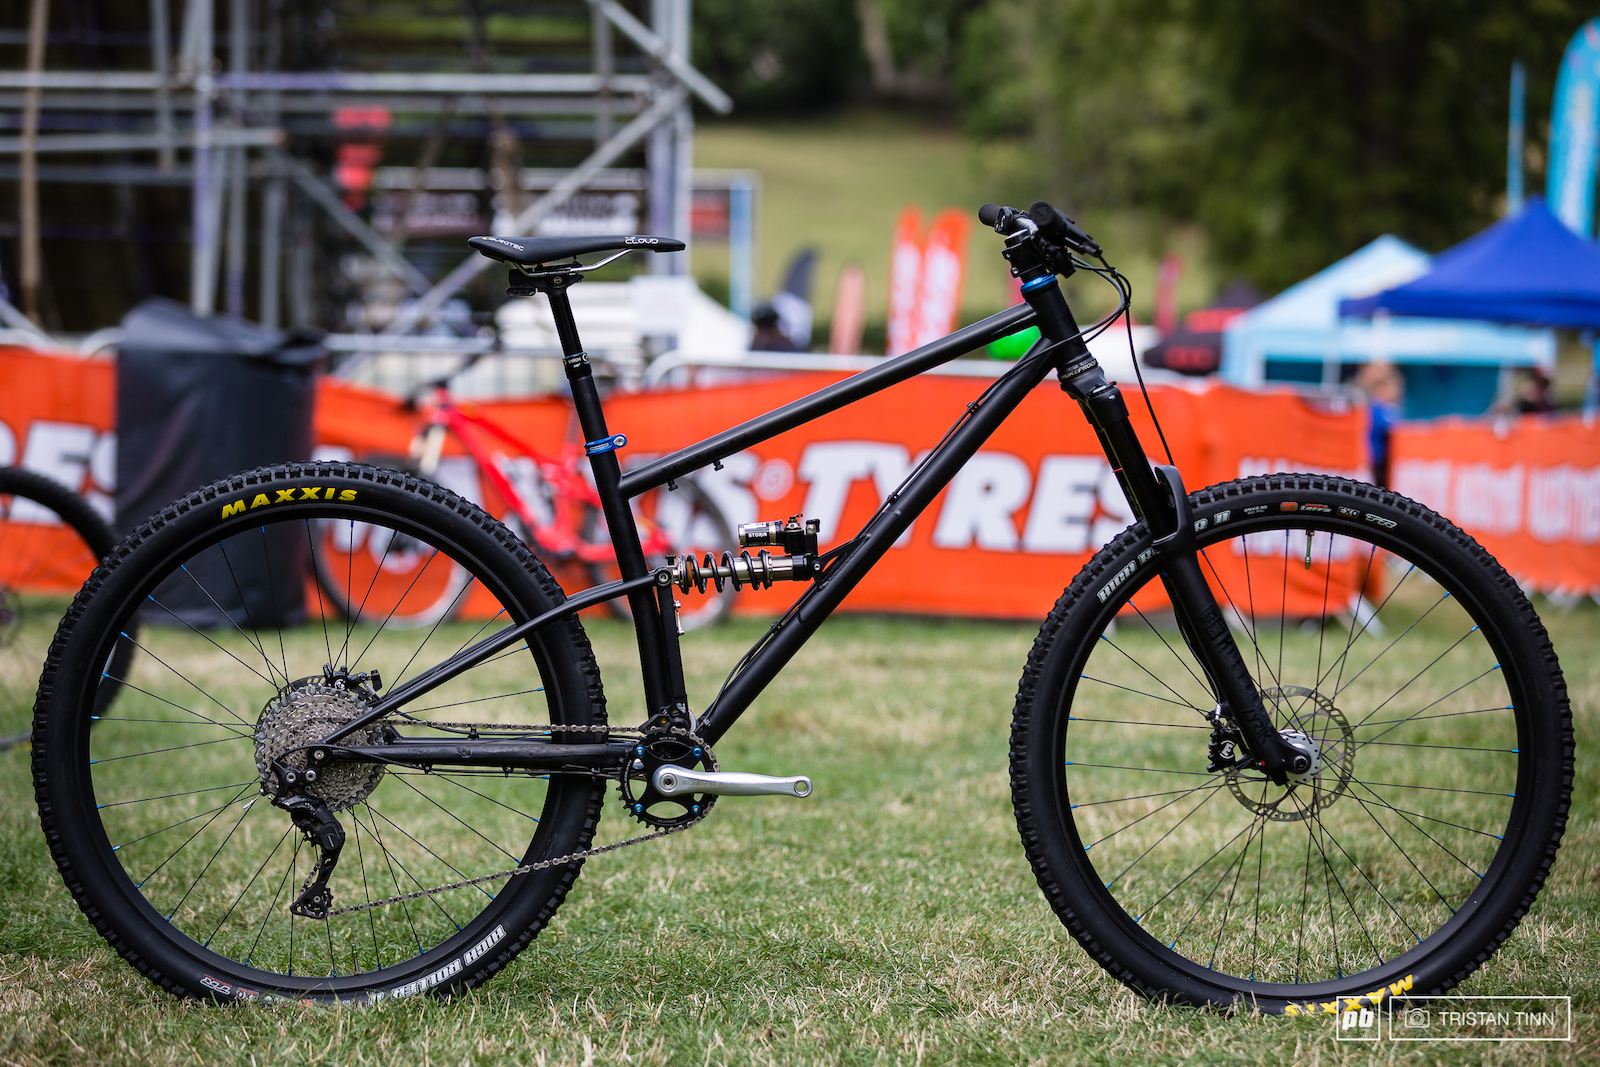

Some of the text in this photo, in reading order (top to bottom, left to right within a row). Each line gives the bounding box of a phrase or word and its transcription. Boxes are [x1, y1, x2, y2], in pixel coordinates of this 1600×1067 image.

[221, 486, 358, 520] MAXXIS
[1097, 560, 1138, 604] HIGH
[464, 923, 507, 967] HIGH
[200, 976, 231, 996] TR
[390, 958, 464, 1000] ROLLER
[1284, 973, 1414, 1016] MAXXIS
